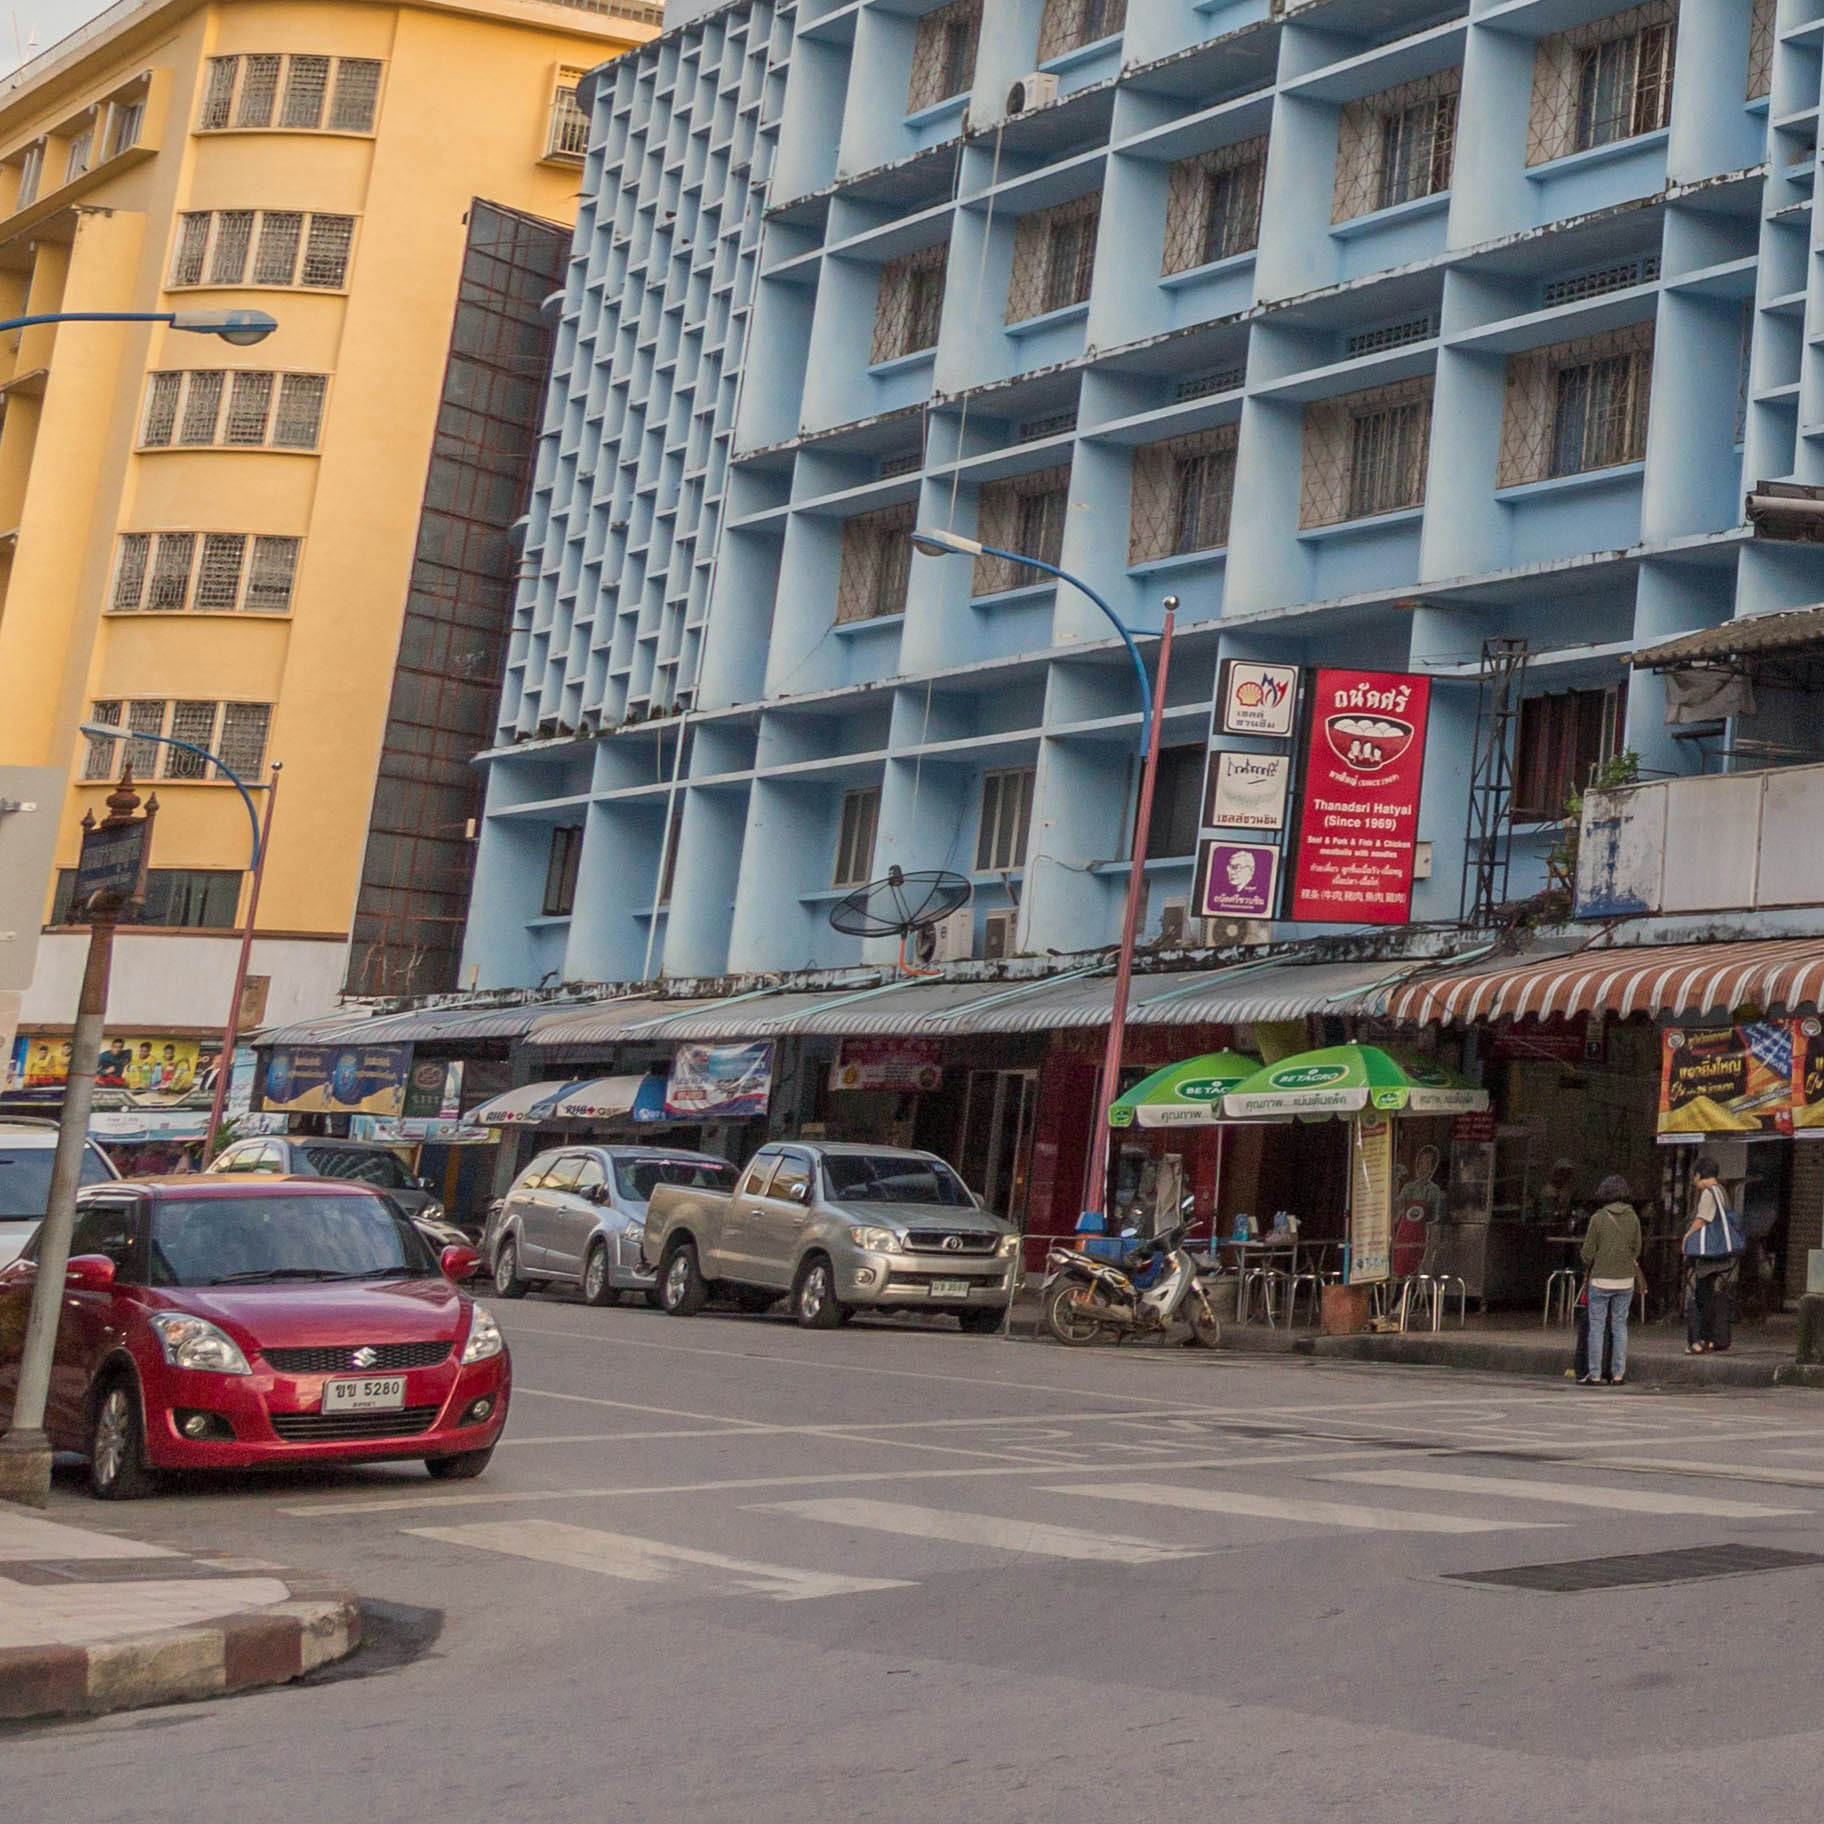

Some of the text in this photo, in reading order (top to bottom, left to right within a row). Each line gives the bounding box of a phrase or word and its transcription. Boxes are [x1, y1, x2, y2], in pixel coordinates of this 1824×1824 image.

[1334, 682, 1411, 712] ถนัดศรี
[1313, 799, 1412, 817] Thanadsri Hatyai
[1324, 815, 1397, 831] (Since 1969)
[1679, 1055, 1742, 1080] แจกยิ่งใหญ่
[1279, 1071, 1340, 1084] BETAGRO
[364, 1381, 400, 1396] 5280
